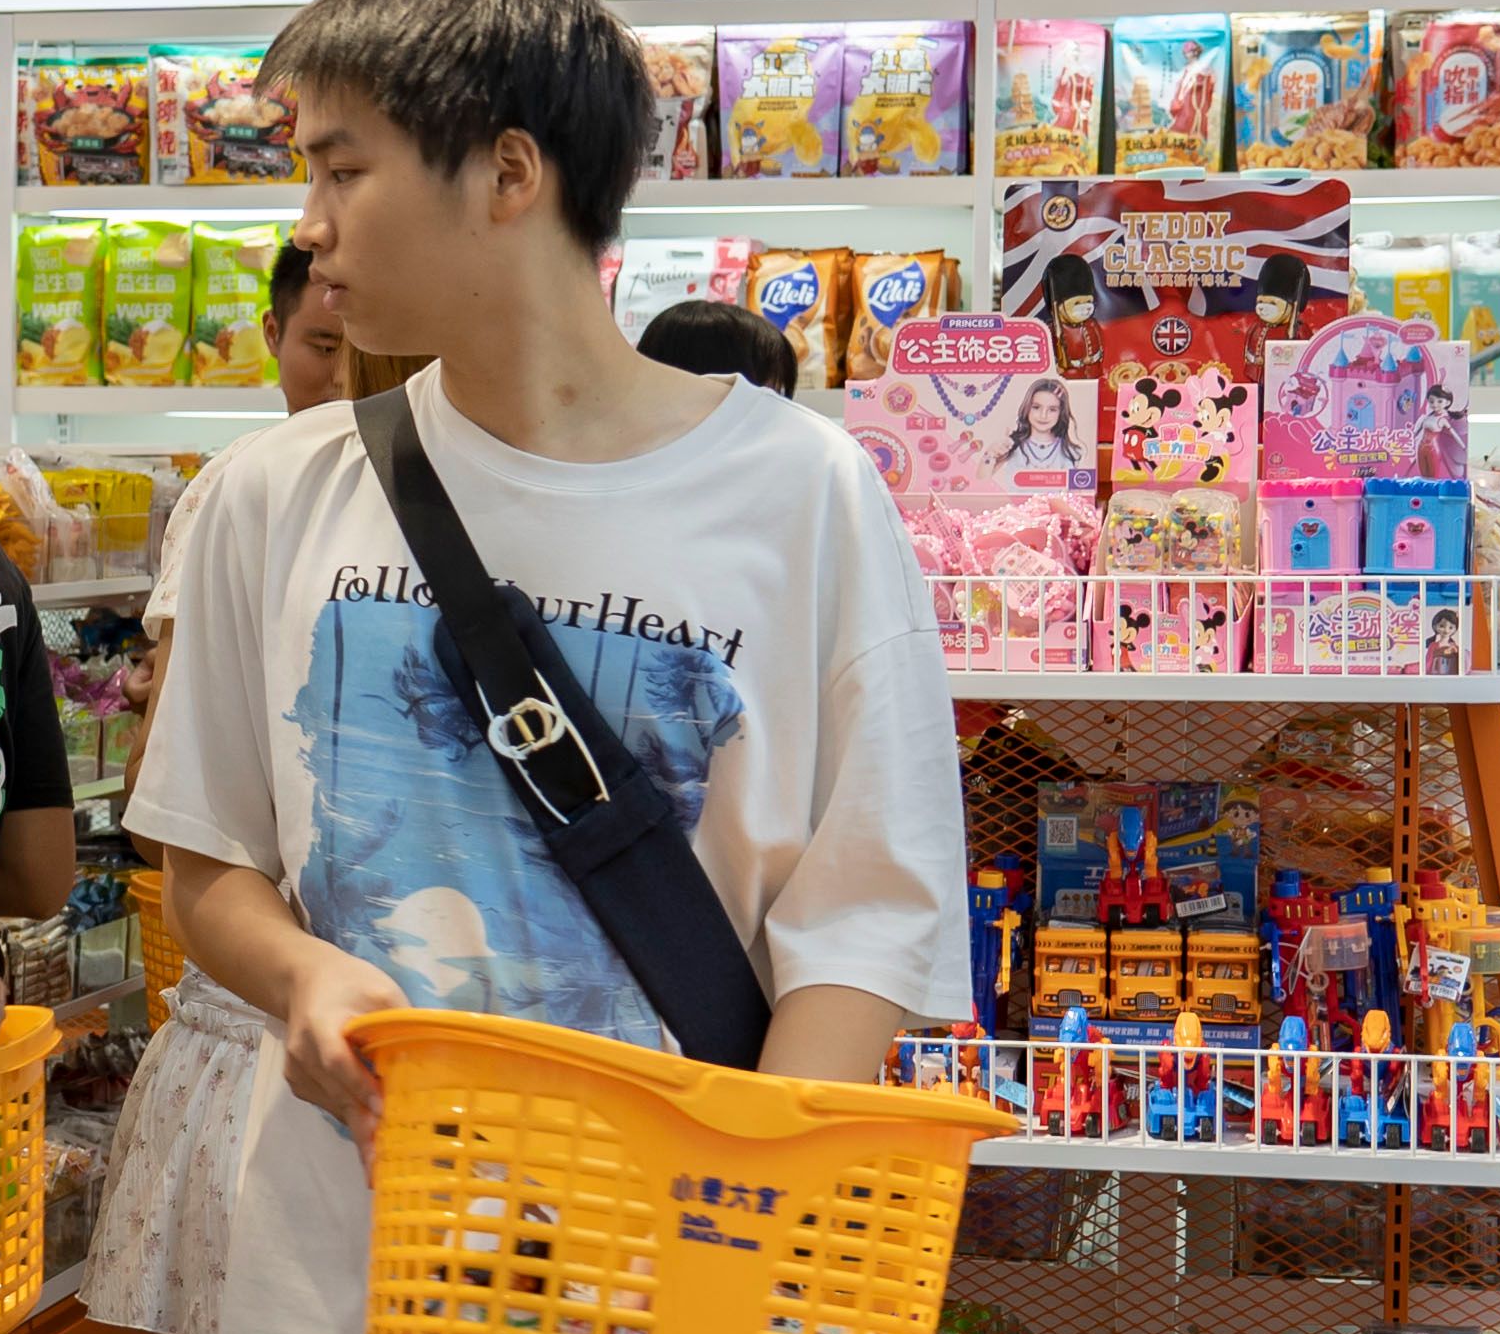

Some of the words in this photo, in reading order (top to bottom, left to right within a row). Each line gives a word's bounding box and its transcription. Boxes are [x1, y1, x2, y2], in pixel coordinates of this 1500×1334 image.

[1120, 211, 1231, 241] TEDDY
[1103, 243, 1247, 273] CLASSIC
[116, 273, 175, 293] 益生菌
[32, 302, 83, 319] WAFER
[116, 303, 173, 320] WAFER
[206, 303, 256, 320] WAFER
[949, 319, 995, 329] PRINCESS
[900, 333, 1041, 364] 公主饰品盒
[1312, 427, 1416, 456] 公主城堡
